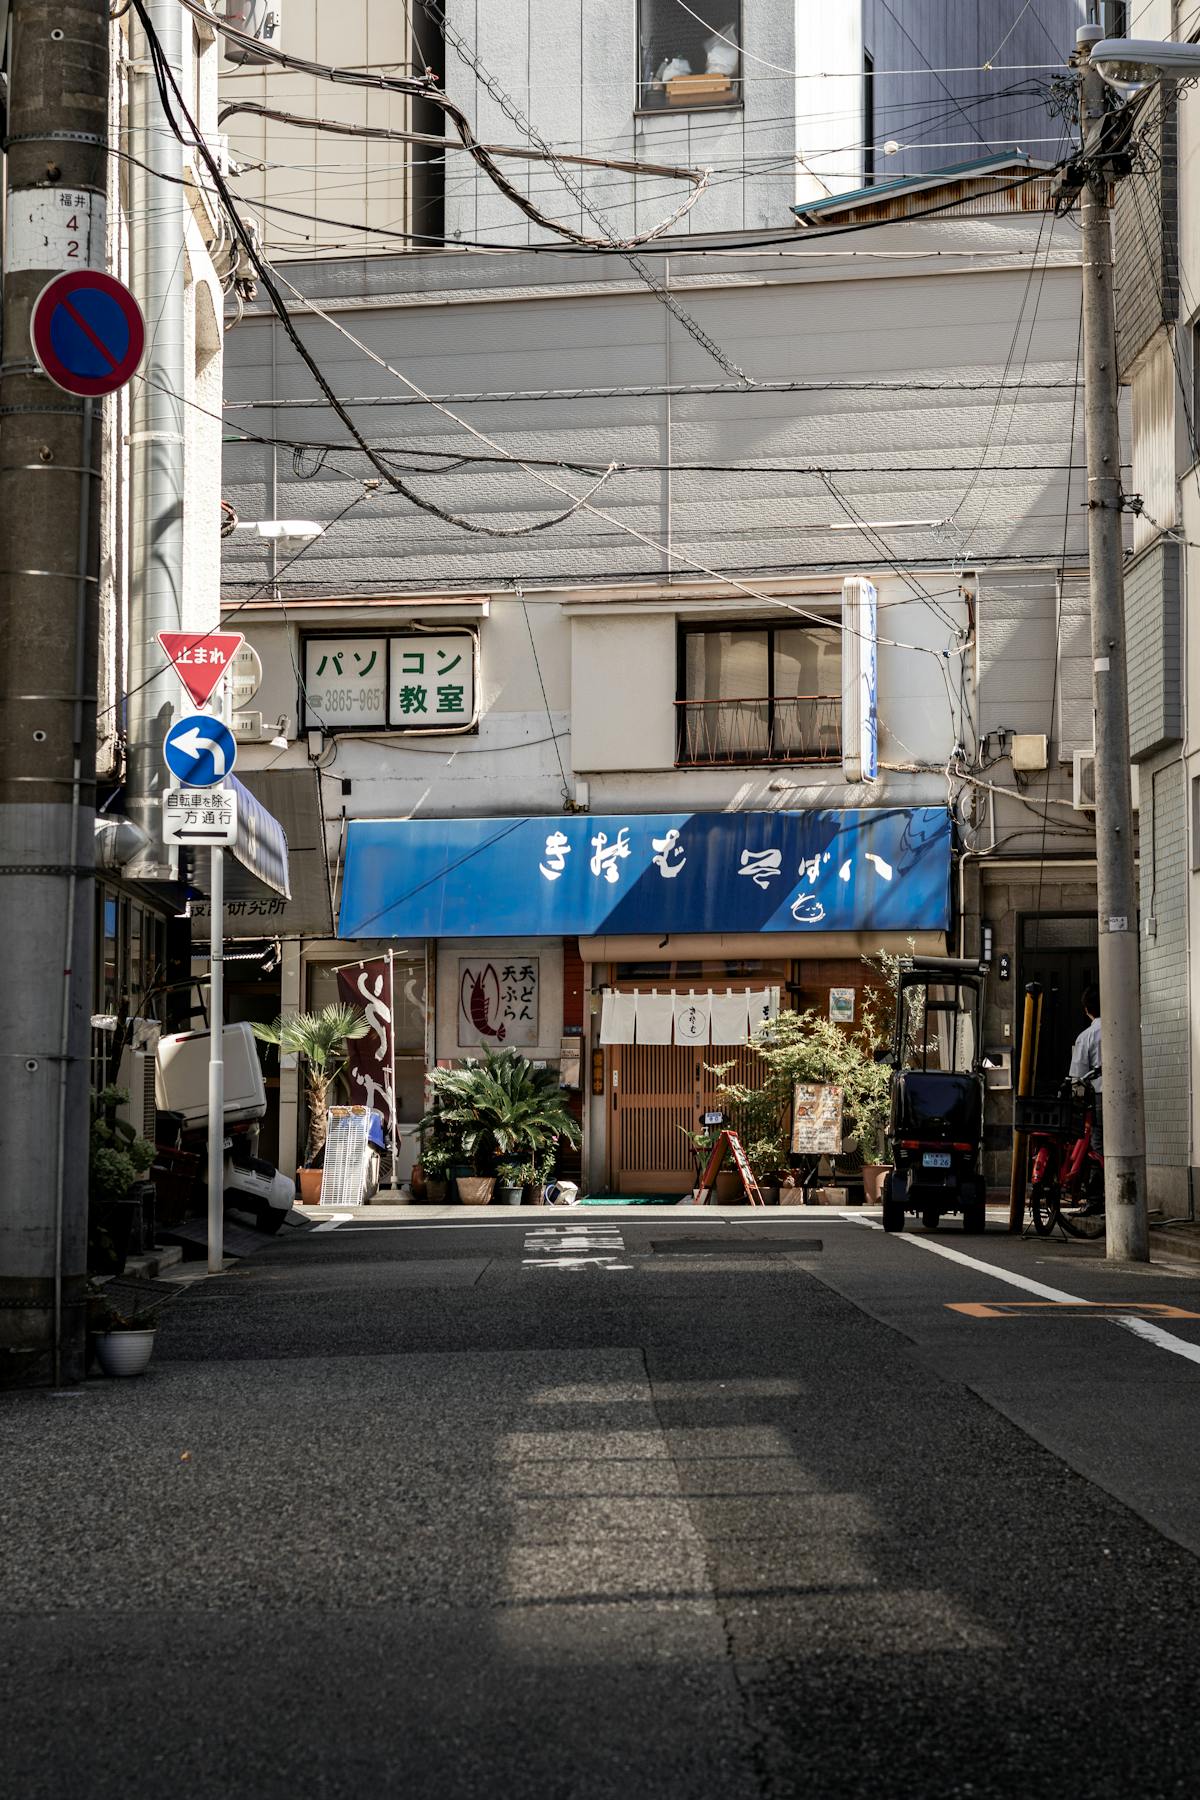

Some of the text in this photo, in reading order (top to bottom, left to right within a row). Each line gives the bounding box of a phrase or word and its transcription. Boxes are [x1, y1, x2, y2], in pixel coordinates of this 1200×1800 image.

[60, 193, 86, 208] 福井
[66, 215, 79, 232] 4
[67, 240, 79, 257] 2
[175, 646, 226, 664] 止まれ
[316, 650, 462, 677] パソコン
[325, 688, 386, 713] 3865-9651
[400, 684, 464, 714] 教室
[168, 793, 231, 807] 自転車を除く
[168, 811, 232, 824] 一方通行
[501, 965, 517, 1021] 天ぷら
[519, 965, 536, 1021] 天どん
